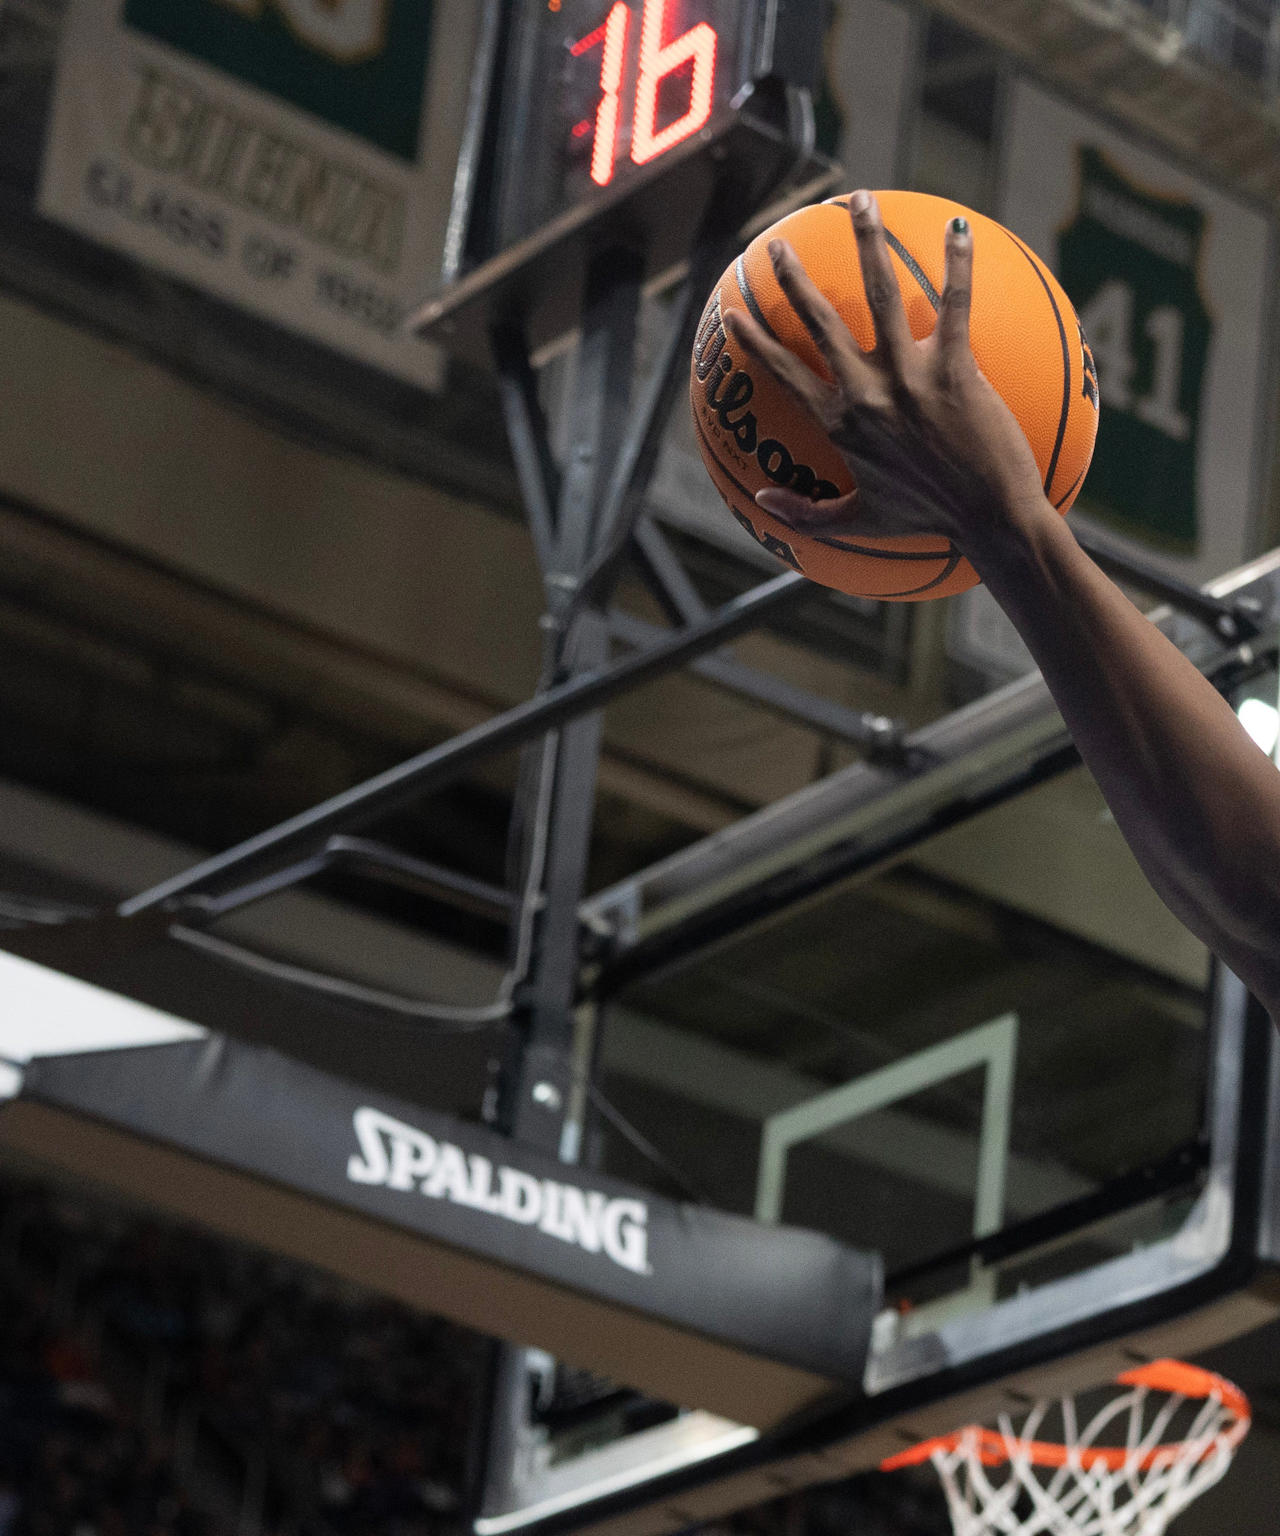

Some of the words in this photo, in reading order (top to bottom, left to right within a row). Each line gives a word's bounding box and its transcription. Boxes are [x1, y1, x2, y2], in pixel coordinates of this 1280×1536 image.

[589, 0, 718, 187] 16
[695, 288, 841, 500] Wilson
[347, 1106, 652, 1275] SPALDING
